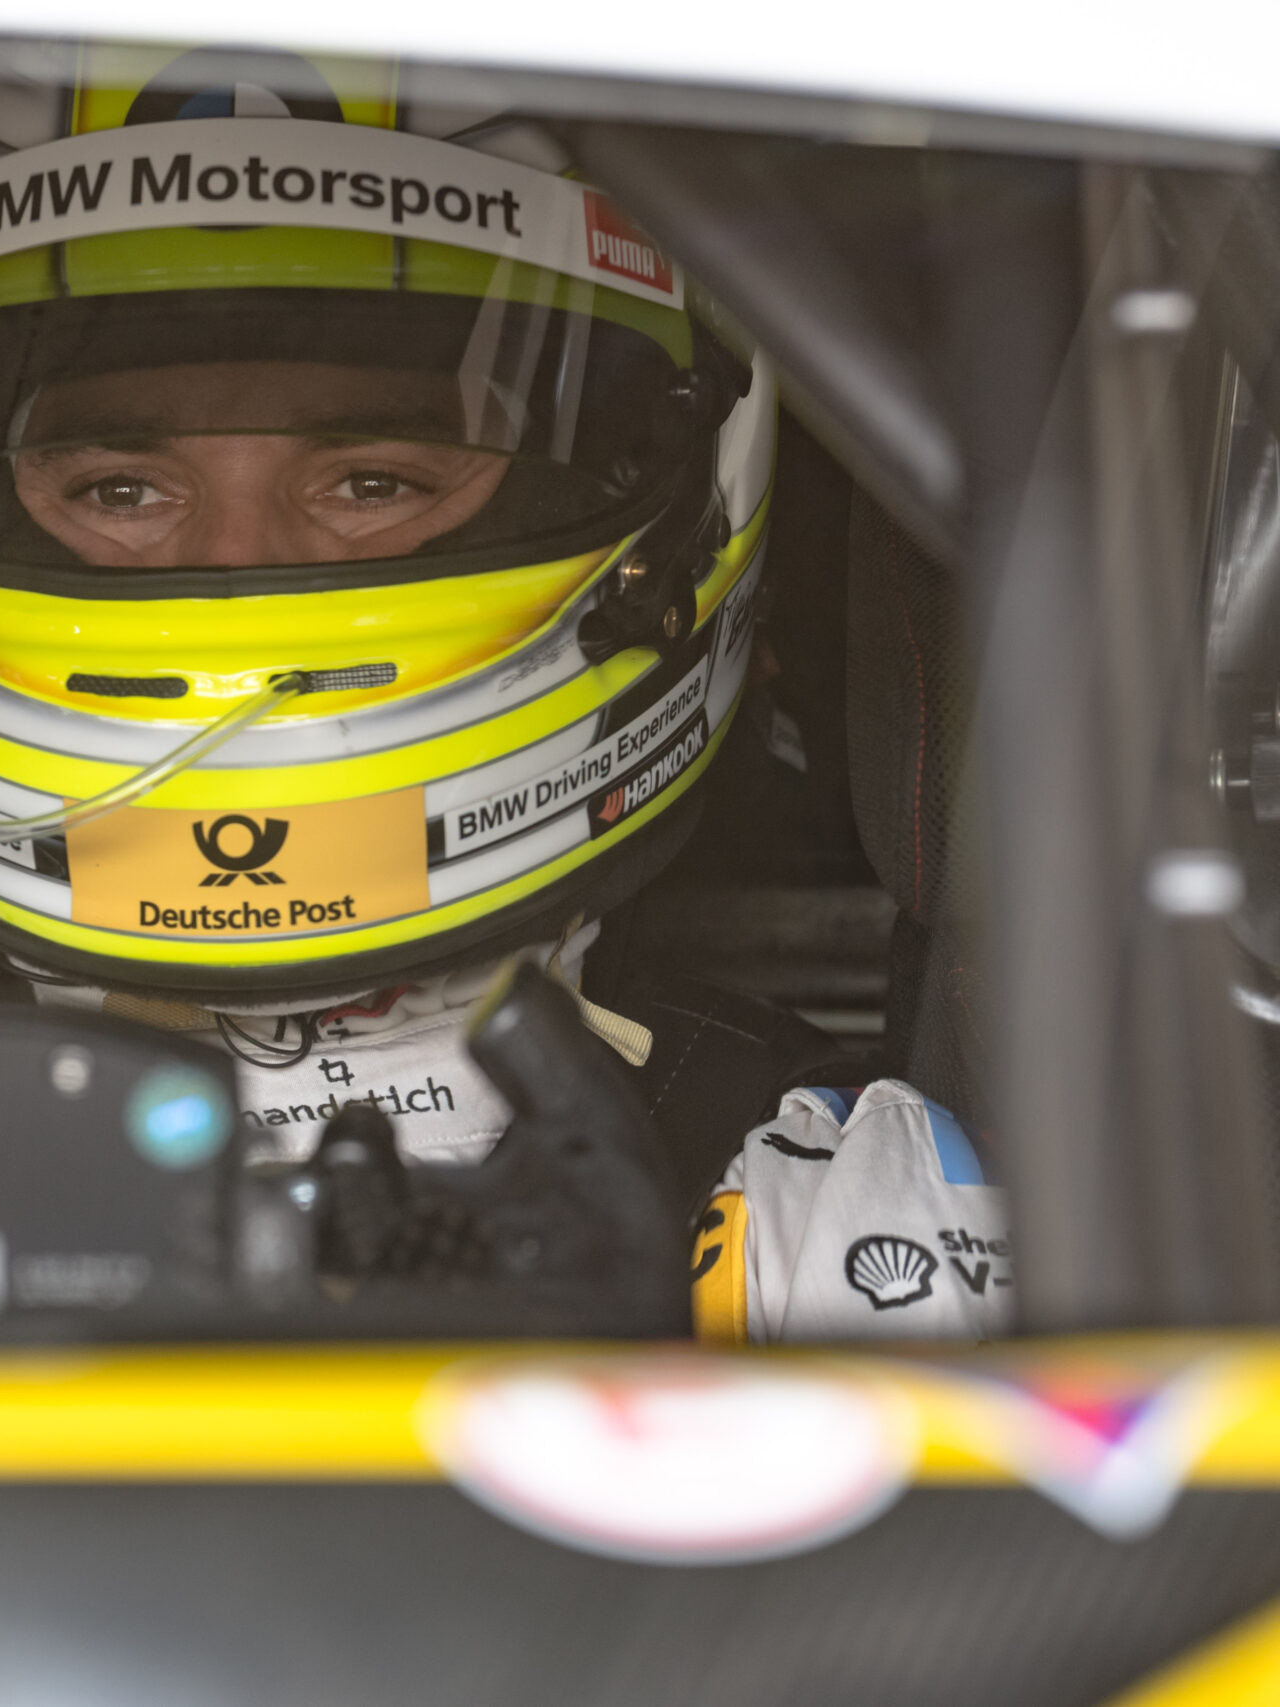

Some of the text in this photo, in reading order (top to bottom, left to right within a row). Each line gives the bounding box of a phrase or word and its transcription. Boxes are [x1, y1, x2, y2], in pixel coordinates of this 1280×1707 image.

[129, 153, 523, 238] Motorsport
[591, 229, 656, 280] PUMA
[458, 675, 703, 841] BMW Driving Experience
[138, 894, 357, 930] Deutsche Post
[237, 1076, 456, 1128] andtich
[937, 1226, 1013, 1257] She
